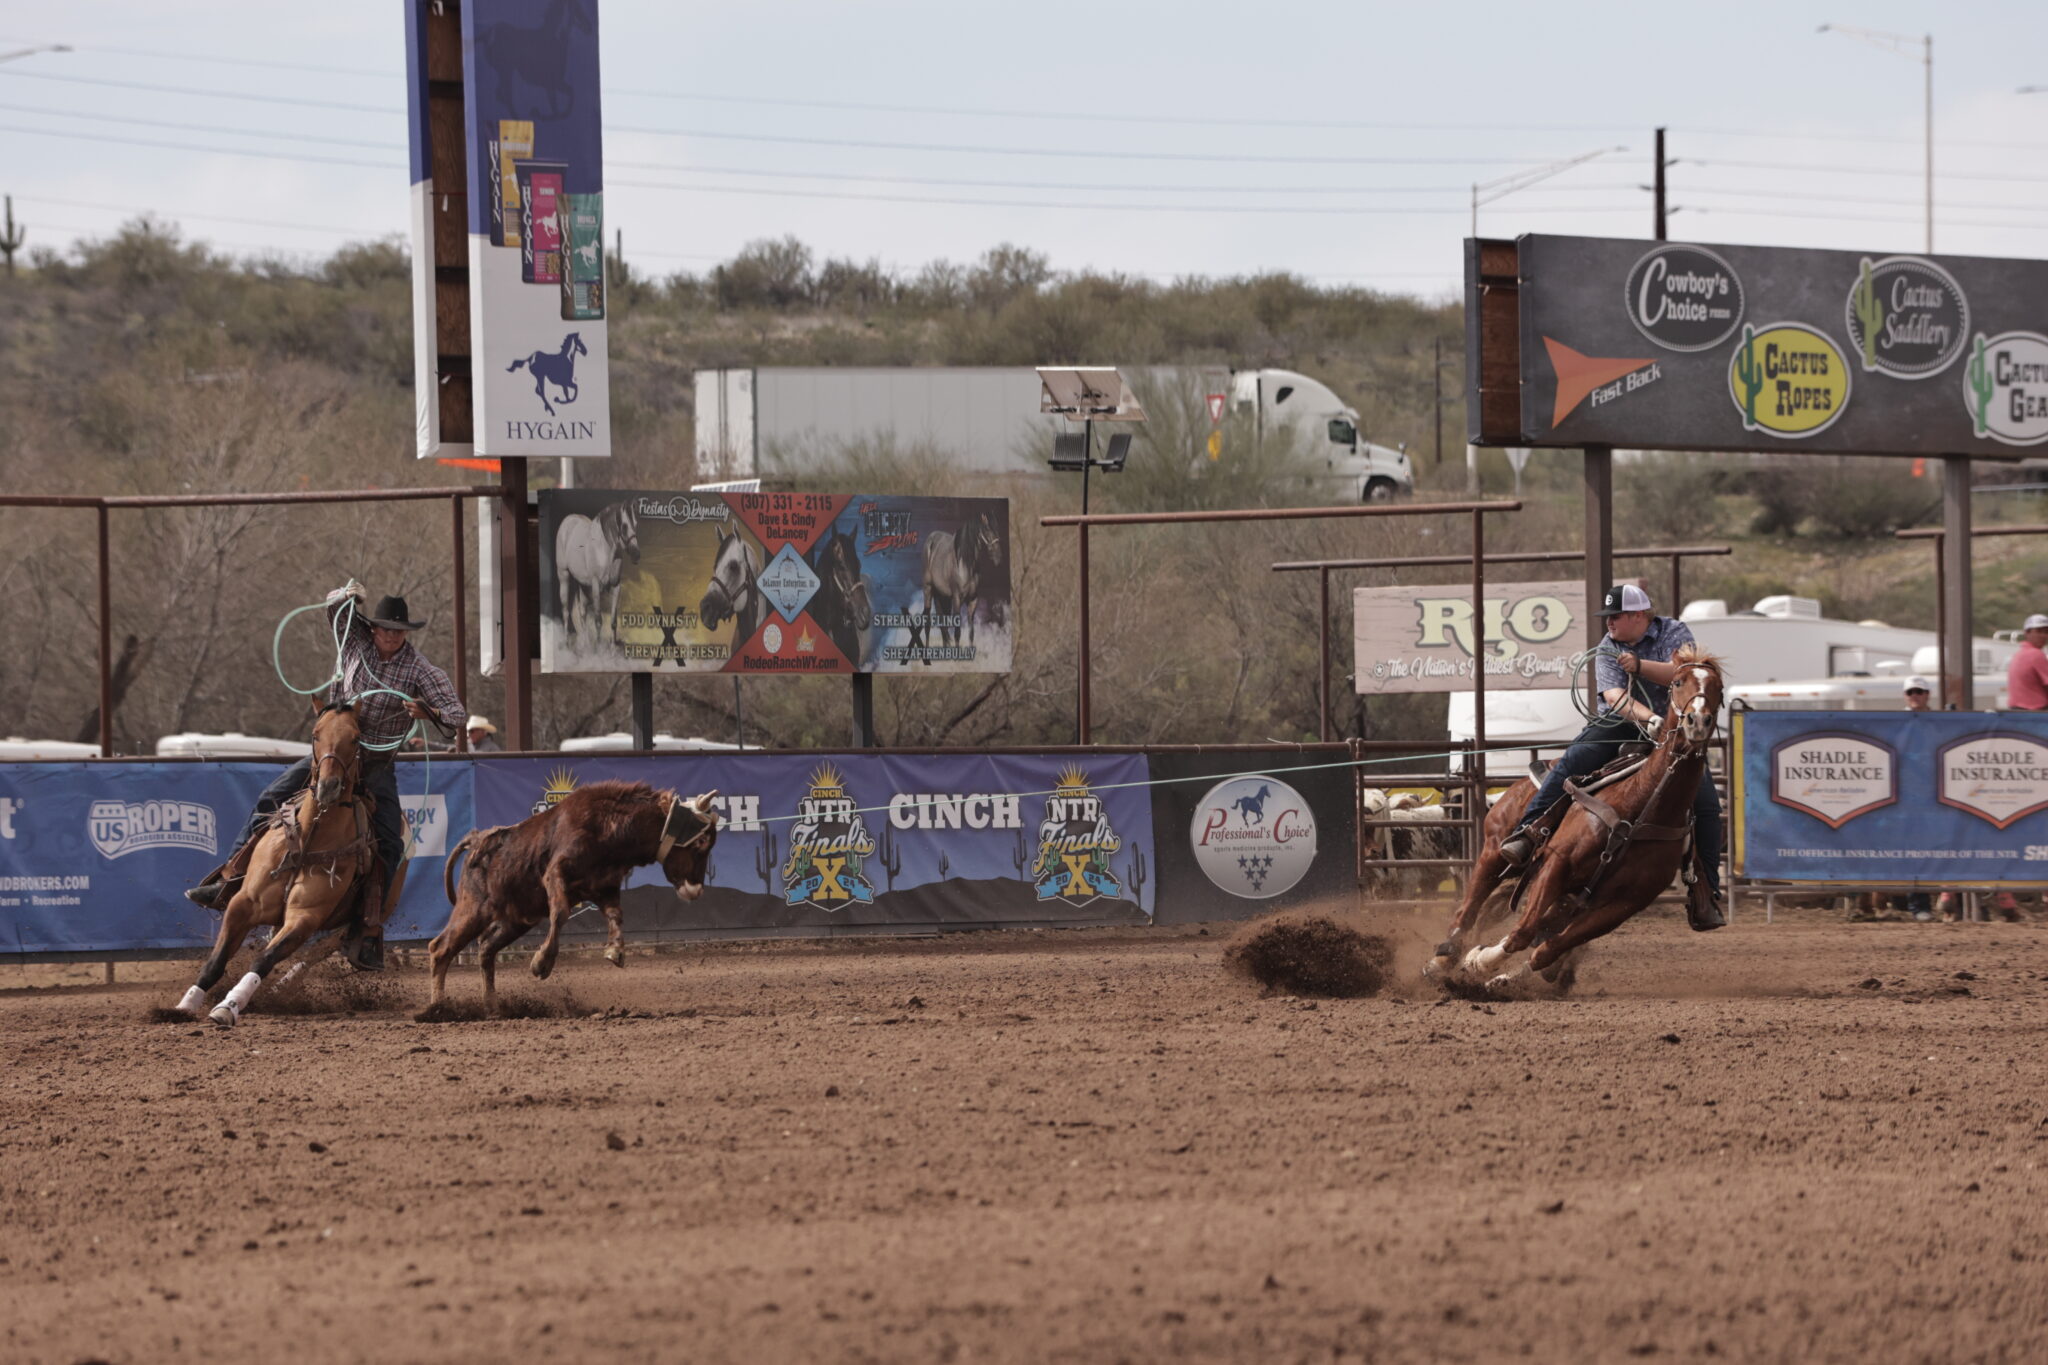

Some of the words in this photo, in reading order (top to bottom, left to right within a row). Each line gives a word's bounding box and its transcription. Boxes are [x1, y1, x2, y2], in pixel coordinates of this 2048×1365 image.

[489, 140, 502, 223] HYGAIN
[522, 186, 534, 264] HYGAIN
[561, 215, 572, 296] HYGAIN
[1891, 275, 1943, 312] Cactus
[1881, 313, 1949, 354] Saddlery
[1765, 342, 1828, 379] CACTUS
[1591, 380, 1623, 408] Fast
[1626, 363, 1662, 392] Back
[1776, 380, 1831, 416] ROPES
[507, 421, 594, 440] HYGAIN
[638, 498, 669, 515] Fiestas
[690, 499, 729, 522] Dynasty
[741, 495, 770, 511] (307)
[773, 495, 792, 509] 331
[805, 495, 832, 510] 2115
[758, 513, 780, 525] Dave
[783, 513, 789, 525] &
[791, 513, 816, 528] Cindy
[766, 527, 808, 542] DeLancey
[622, 613, 645, 626] FDD
[648, 613, 698, 628] DYNASTY
[873, 614, 911, 627] STREAK
[913, 614, 928, 627] OF
[930, 614, 961, 627] FLING
[1414, 596, 1574, 661] RIO
[625, 645, 688, 658] FIREWATER
[690, 645, 728, 658] FIESTA
[743, 656, 838, 669] RodeoRanchWY.com
[1387, 657, 1408, 677] The
[1410, 656, 1466, 680] Nation's
[1517, 652, 1566, 680] Bounty
[1800, 751, 1867, 764] SHADLE
[1966, 751, 2035, 765] SHADLE
[1785, 766, 1884, 780] INSURANCE
[1951, 767, 2048, 780] INSURANCE
[547, 793, 570, 803] CIN
[812, 789, 841, 798] CINCH
[1058, 788, 1087, 797] CINCH
[127, 802, 214, 839] ROPER
[803, 799, 851, 824] NTR
[888, 793, 1022, 829] CINCH
[1050, 798, 1098, 822] NTR
[96, 822, 124, 842] US
[1198, 808, 1270, 846] Professional's
[1273, 809, 1311, 843] Choice
[783, 816, 874, 878] Finals
[1033, 813, 1120, 874] Finals
[1776, 848, 1797, 857] THE
[1798, 848, 1842, 857] OFFICIAL
[1845, 849, 1903, 858] INSURANCE
[1905, 849, 1957, 858] PROVIDER
[1959, 849, 1973, 858] OF
[806, 878, 818, 890] 20
[812, 857, 849, 900] X
[1055, 873, 1067, 885] 20
[1061, 854, 1093, 896] X
[32, 895, 81, 906] Recreation
